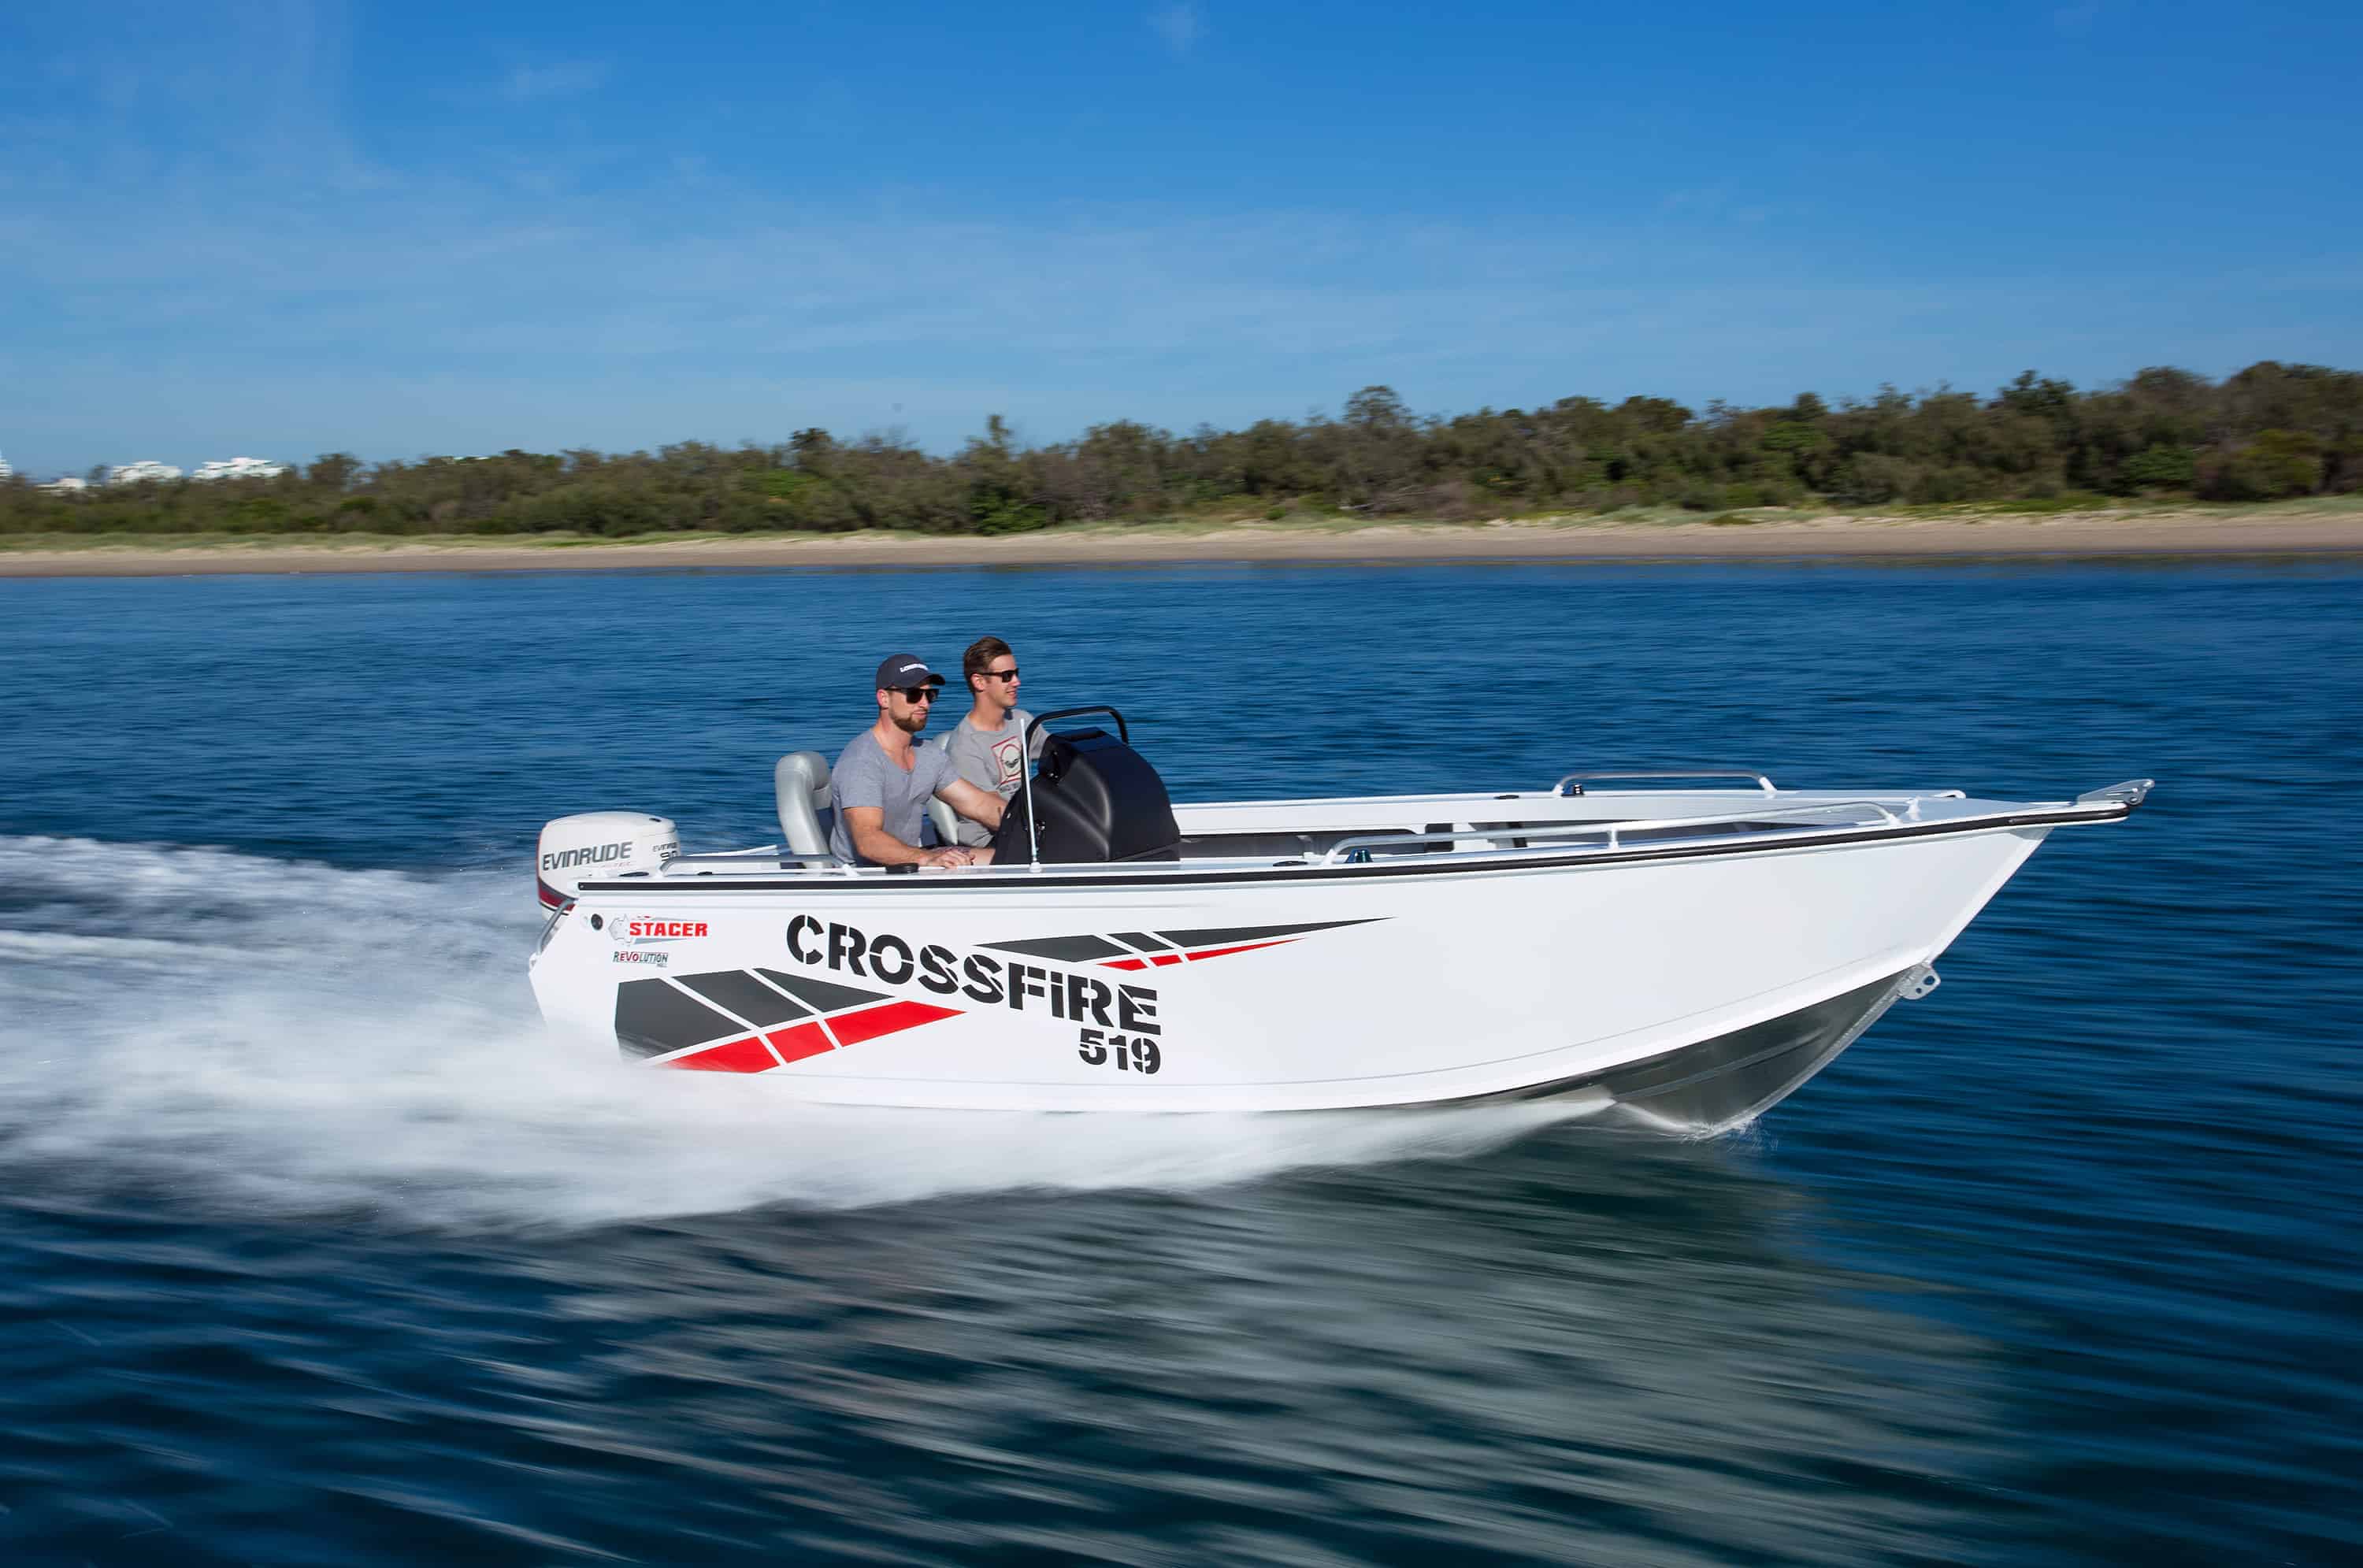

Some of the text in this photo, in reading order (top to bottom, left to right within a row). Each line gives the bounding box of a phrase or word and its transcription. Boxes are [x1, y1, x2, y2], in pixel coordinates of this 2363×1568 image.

[543, 842, 632, 871] EVINRUDE
[629, 922, 708, 937] STACER
[612, 951, 669, 963] REVOLUTION
[786, 914, 1161, 1035] CROSSFIRE
[1078, 1028, 1161, 1074] 519
